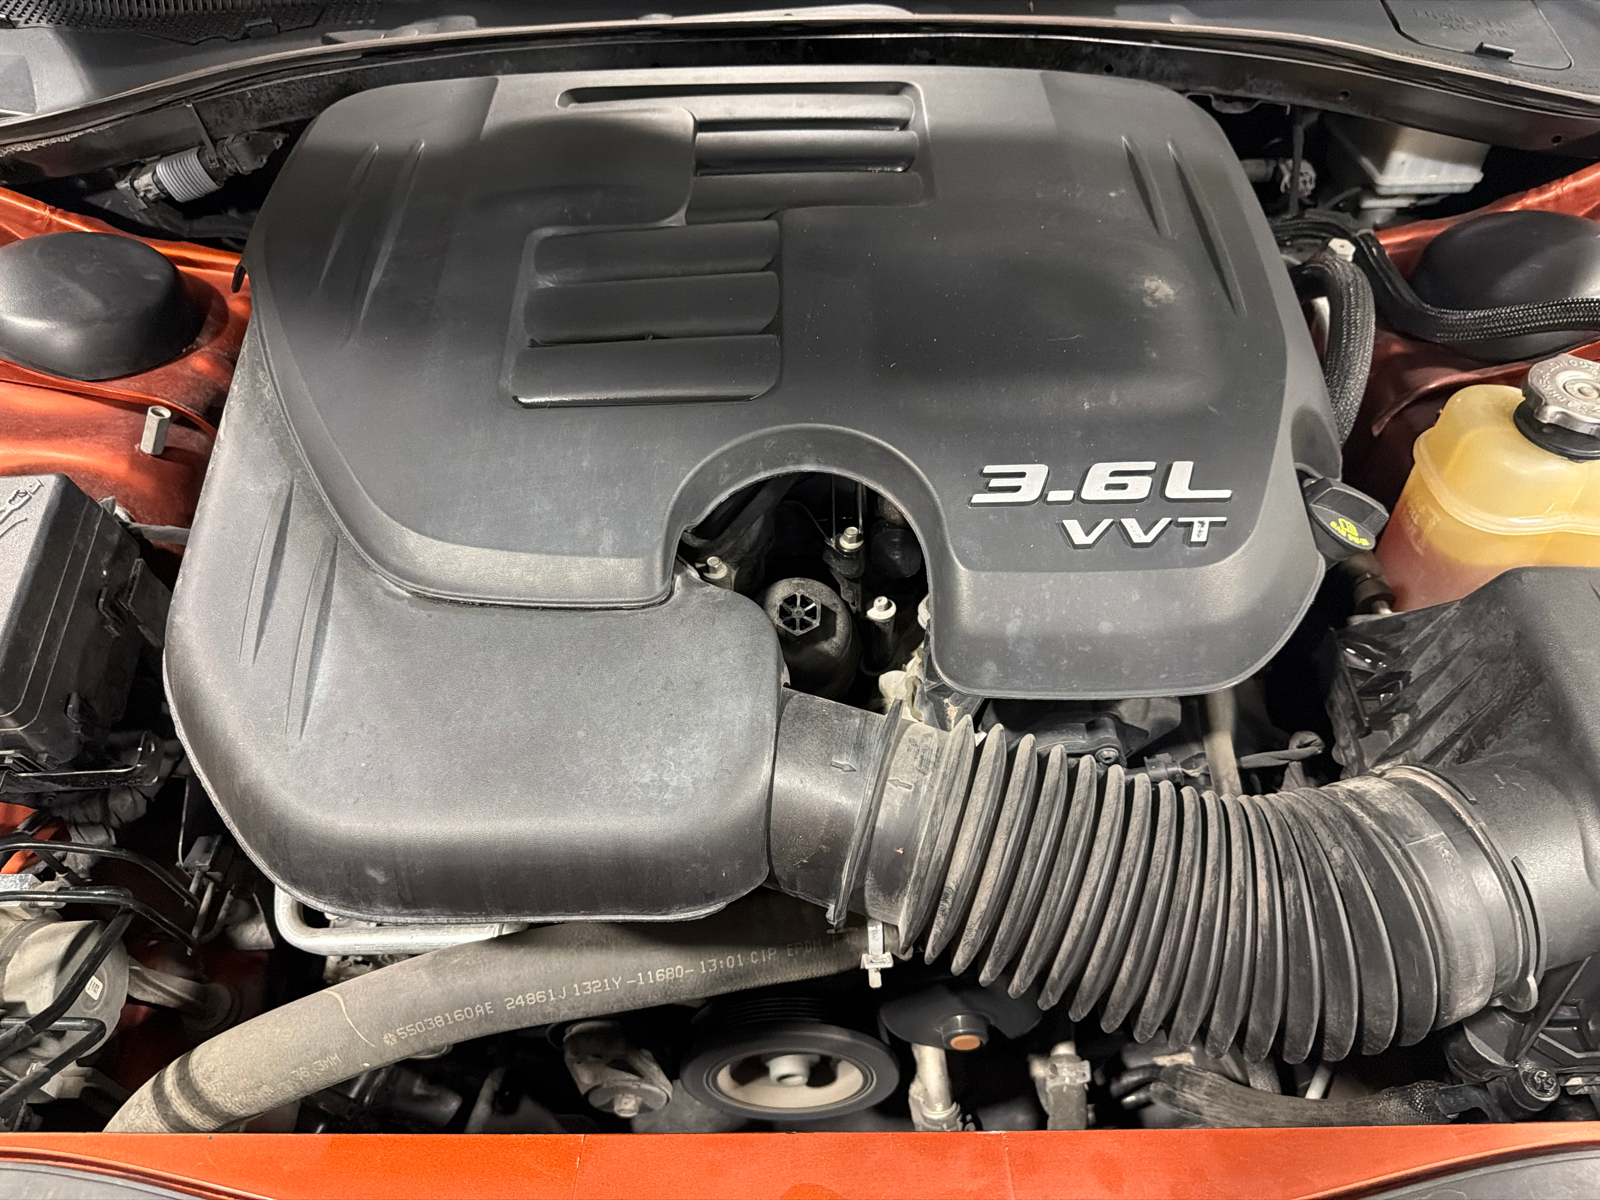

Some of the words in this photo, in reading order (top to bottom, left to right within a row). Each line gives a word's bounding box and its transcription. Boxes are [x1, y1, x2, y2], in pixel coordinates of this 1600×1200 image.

[969, 461, 1232, 506] 3.6L
[1059, 516, 1227, 548] VVT
[396, 1001, 494, 1040] 55038160AE
[504, 987, 567, 1010] 24861J
[700, 954, 744, 974] 13:01
